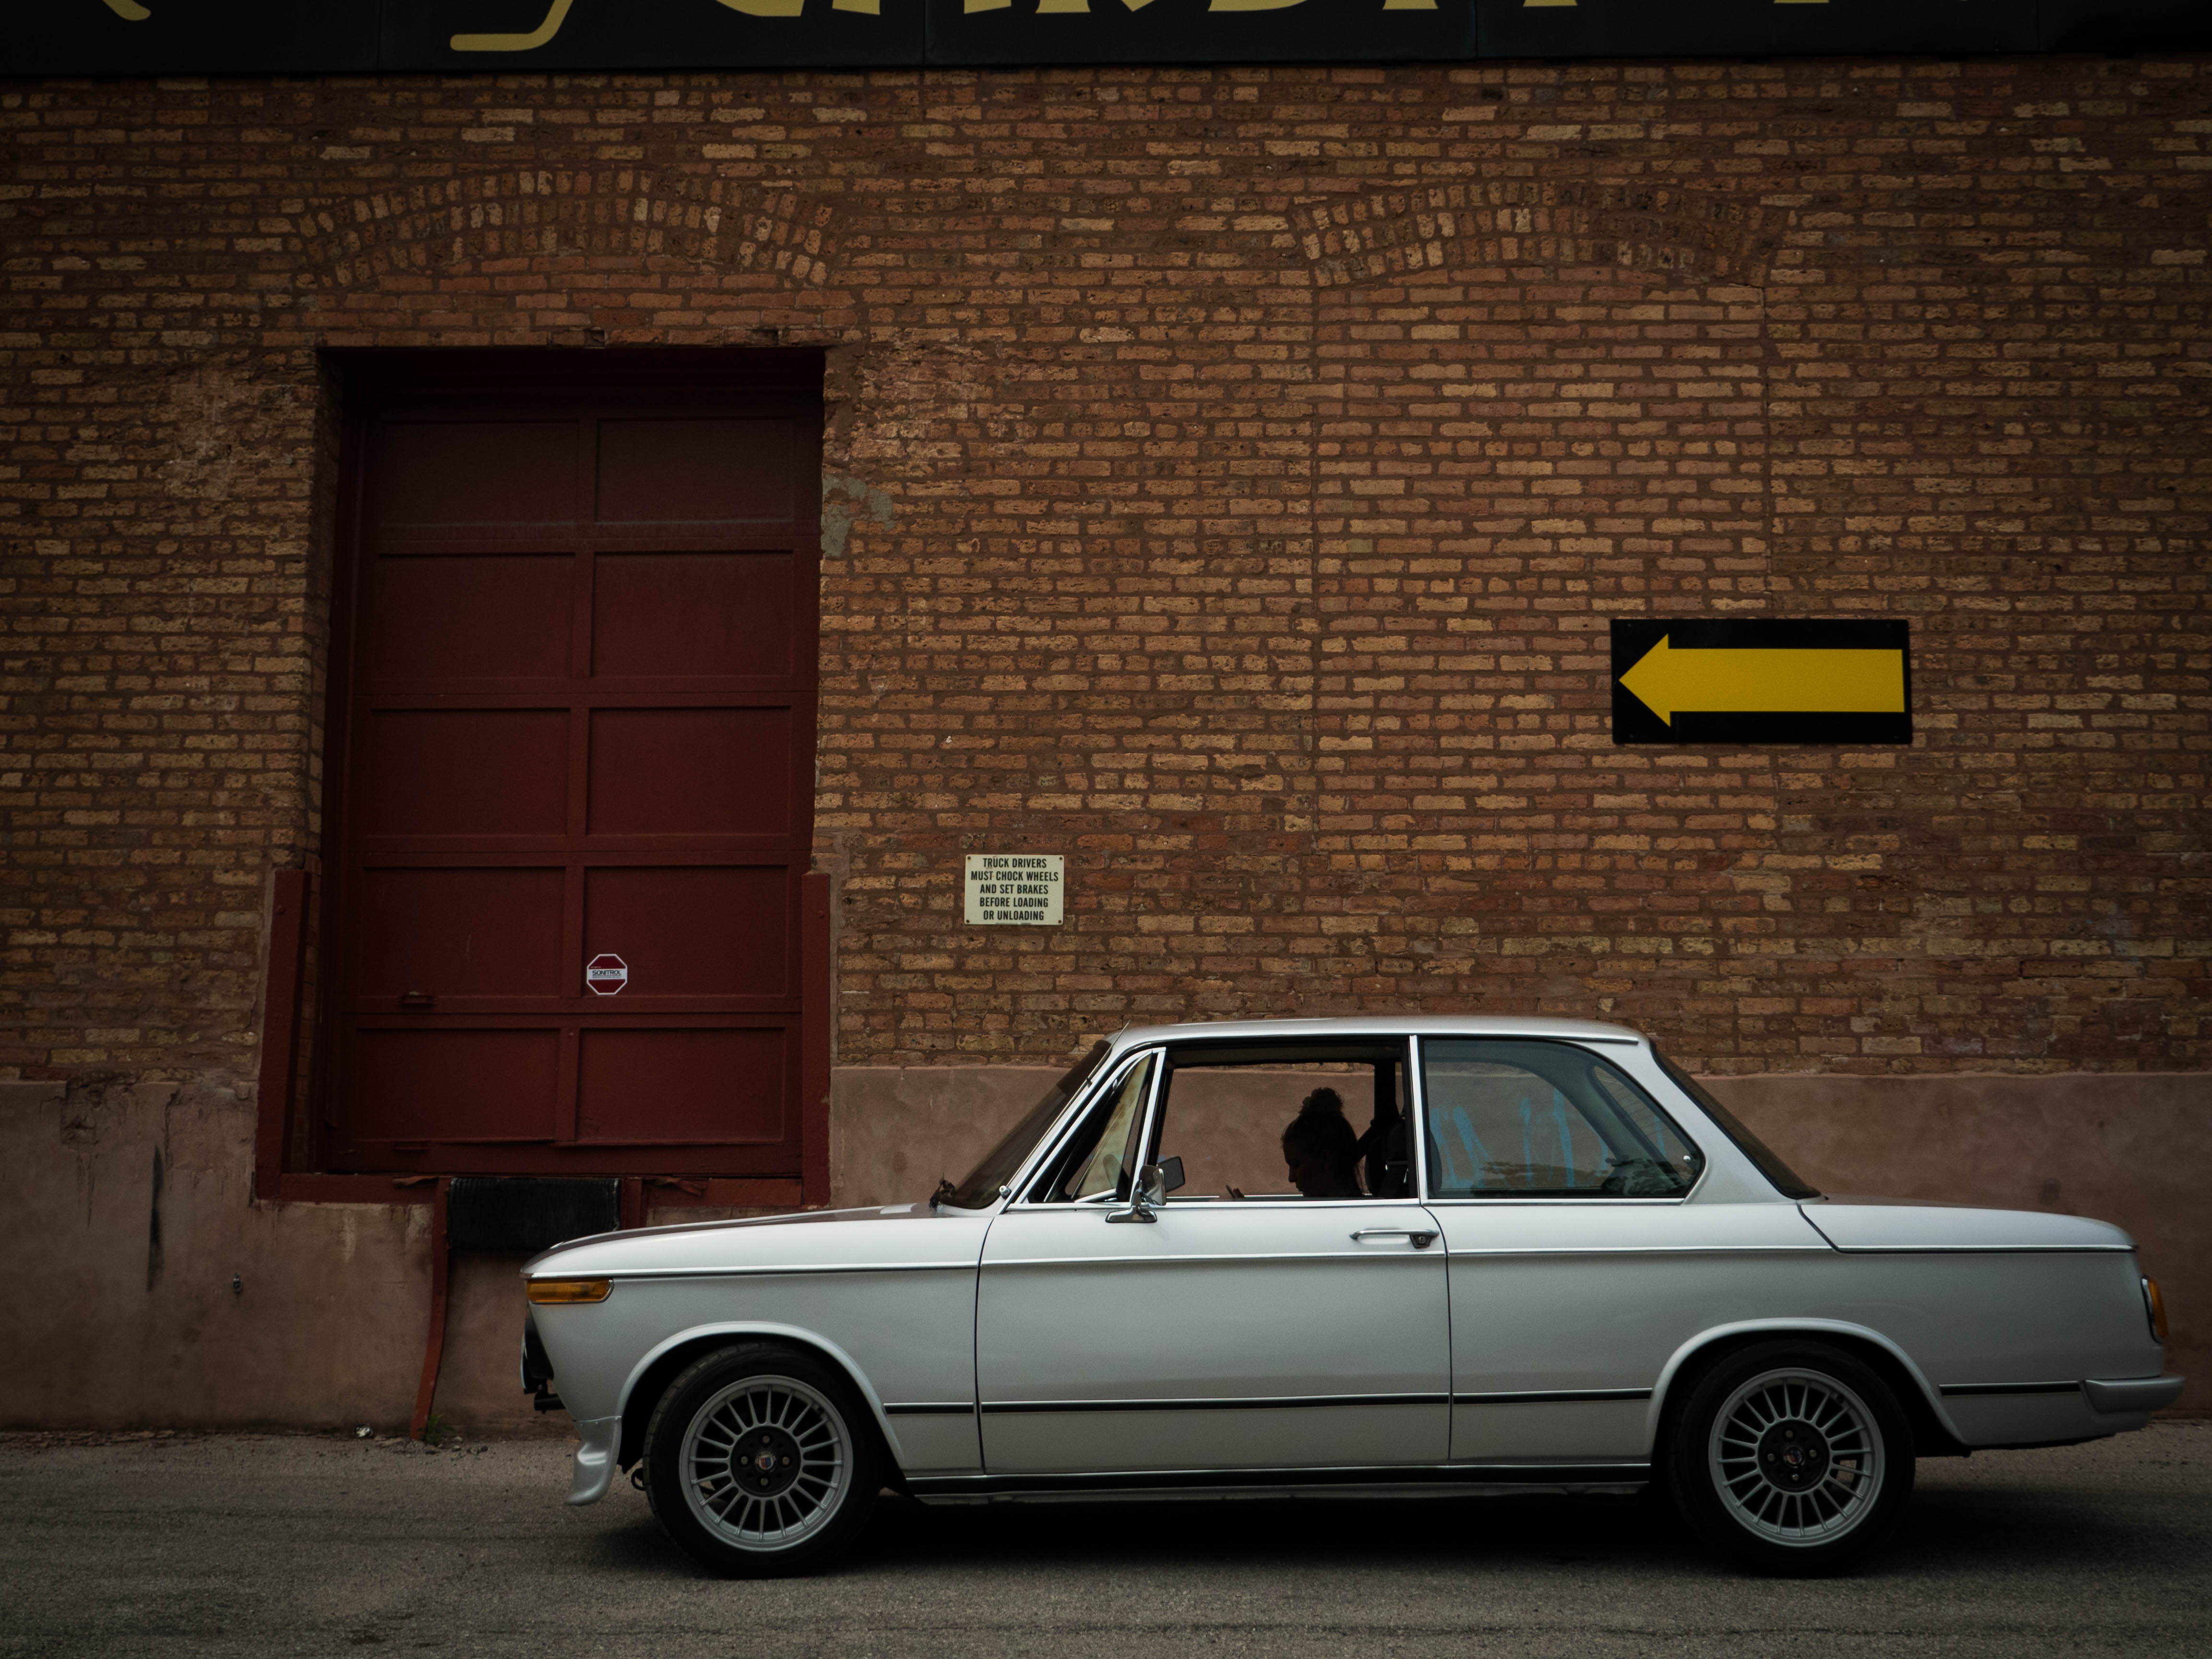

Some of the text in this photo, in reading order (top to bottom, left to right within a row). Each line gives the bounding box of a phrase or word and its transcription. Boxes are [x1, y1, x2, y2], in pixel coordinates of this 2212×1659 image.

[983, 858, 1046, 868] TRUCK DRIVERS
[971, 871, 1058, 881] MUST CHOCK WHEELS
[980, 884, 1048, 894] AND SET BRAKES
[980, 897, 1048, 907] BEFORE LOADING
[984, 910, 1044, 920] OR UNLOADING
